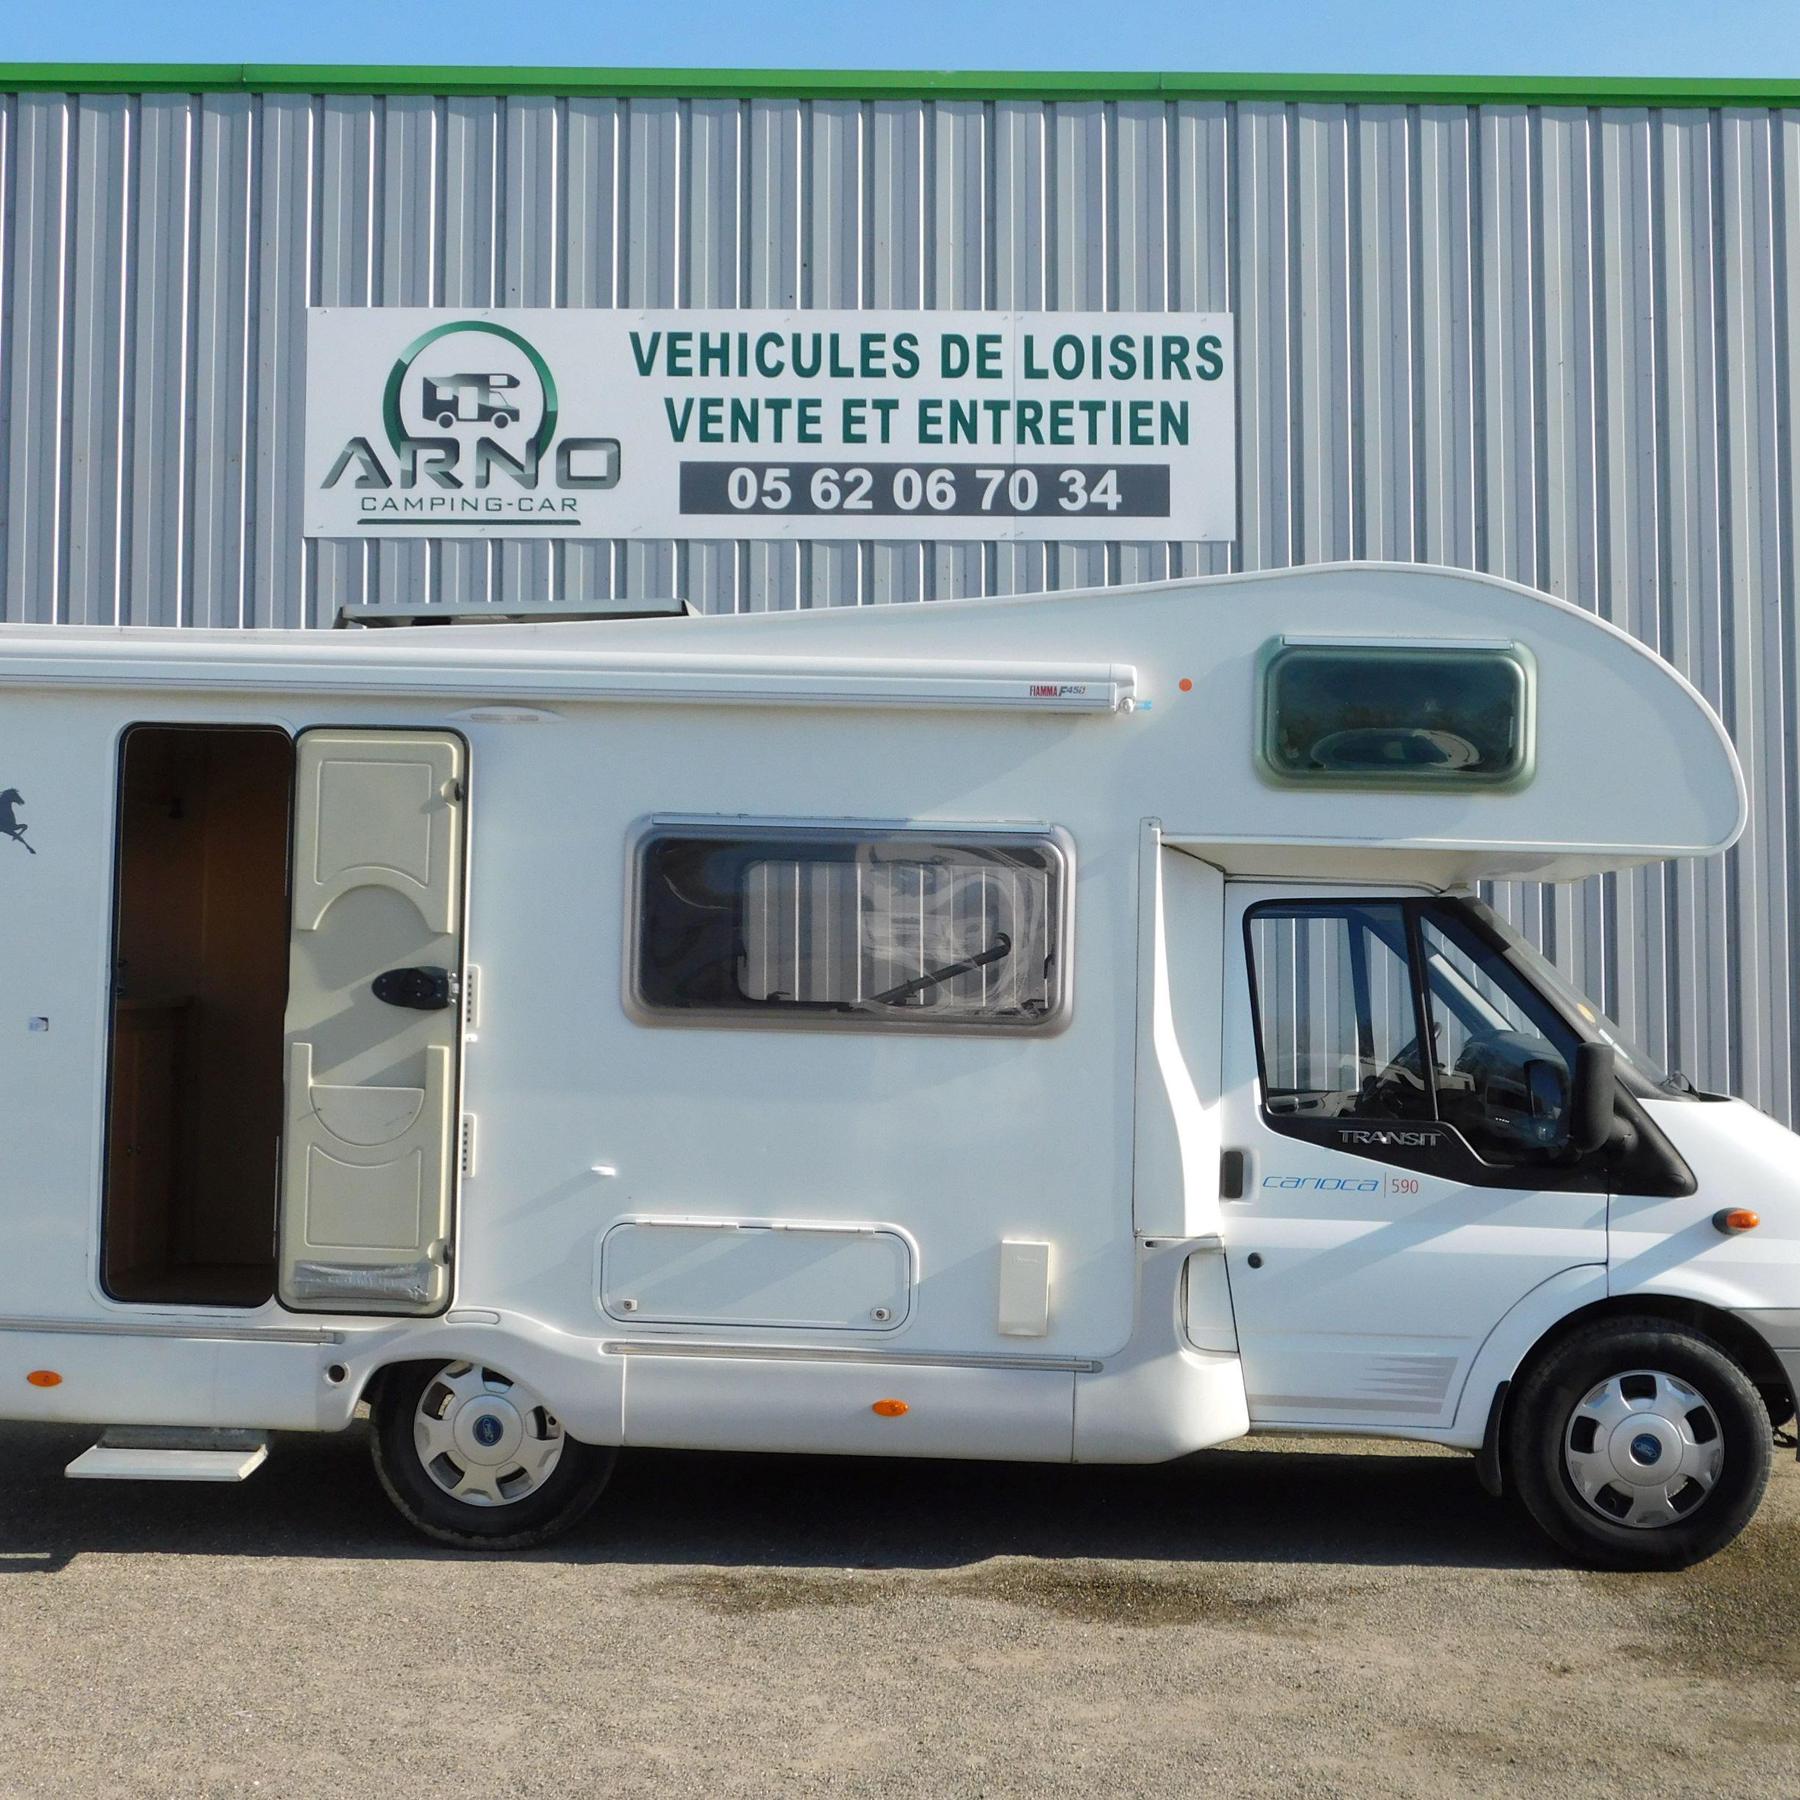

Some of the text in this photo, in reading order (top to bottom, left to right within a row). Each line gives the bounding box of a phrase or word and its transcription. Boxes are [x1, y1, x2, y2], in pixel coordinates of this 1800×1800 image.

[629, 331, 1225, 382] VEHICULES DE LOISIRS
[663, 397, 1190, 446] VENTE ET ENTRETIEN
[320, 435, 622, 491] ARNO
[361, 496, 578, 512] CAMPING-CAR
[727, 467, 1122, 511] 05 62 06 70 34
[1029, 685, 1058, 697] FIAMMA
[1338, 1129, 1441, 1147] TRANSIT
[1391, 1178, 1419, 1194] 590
